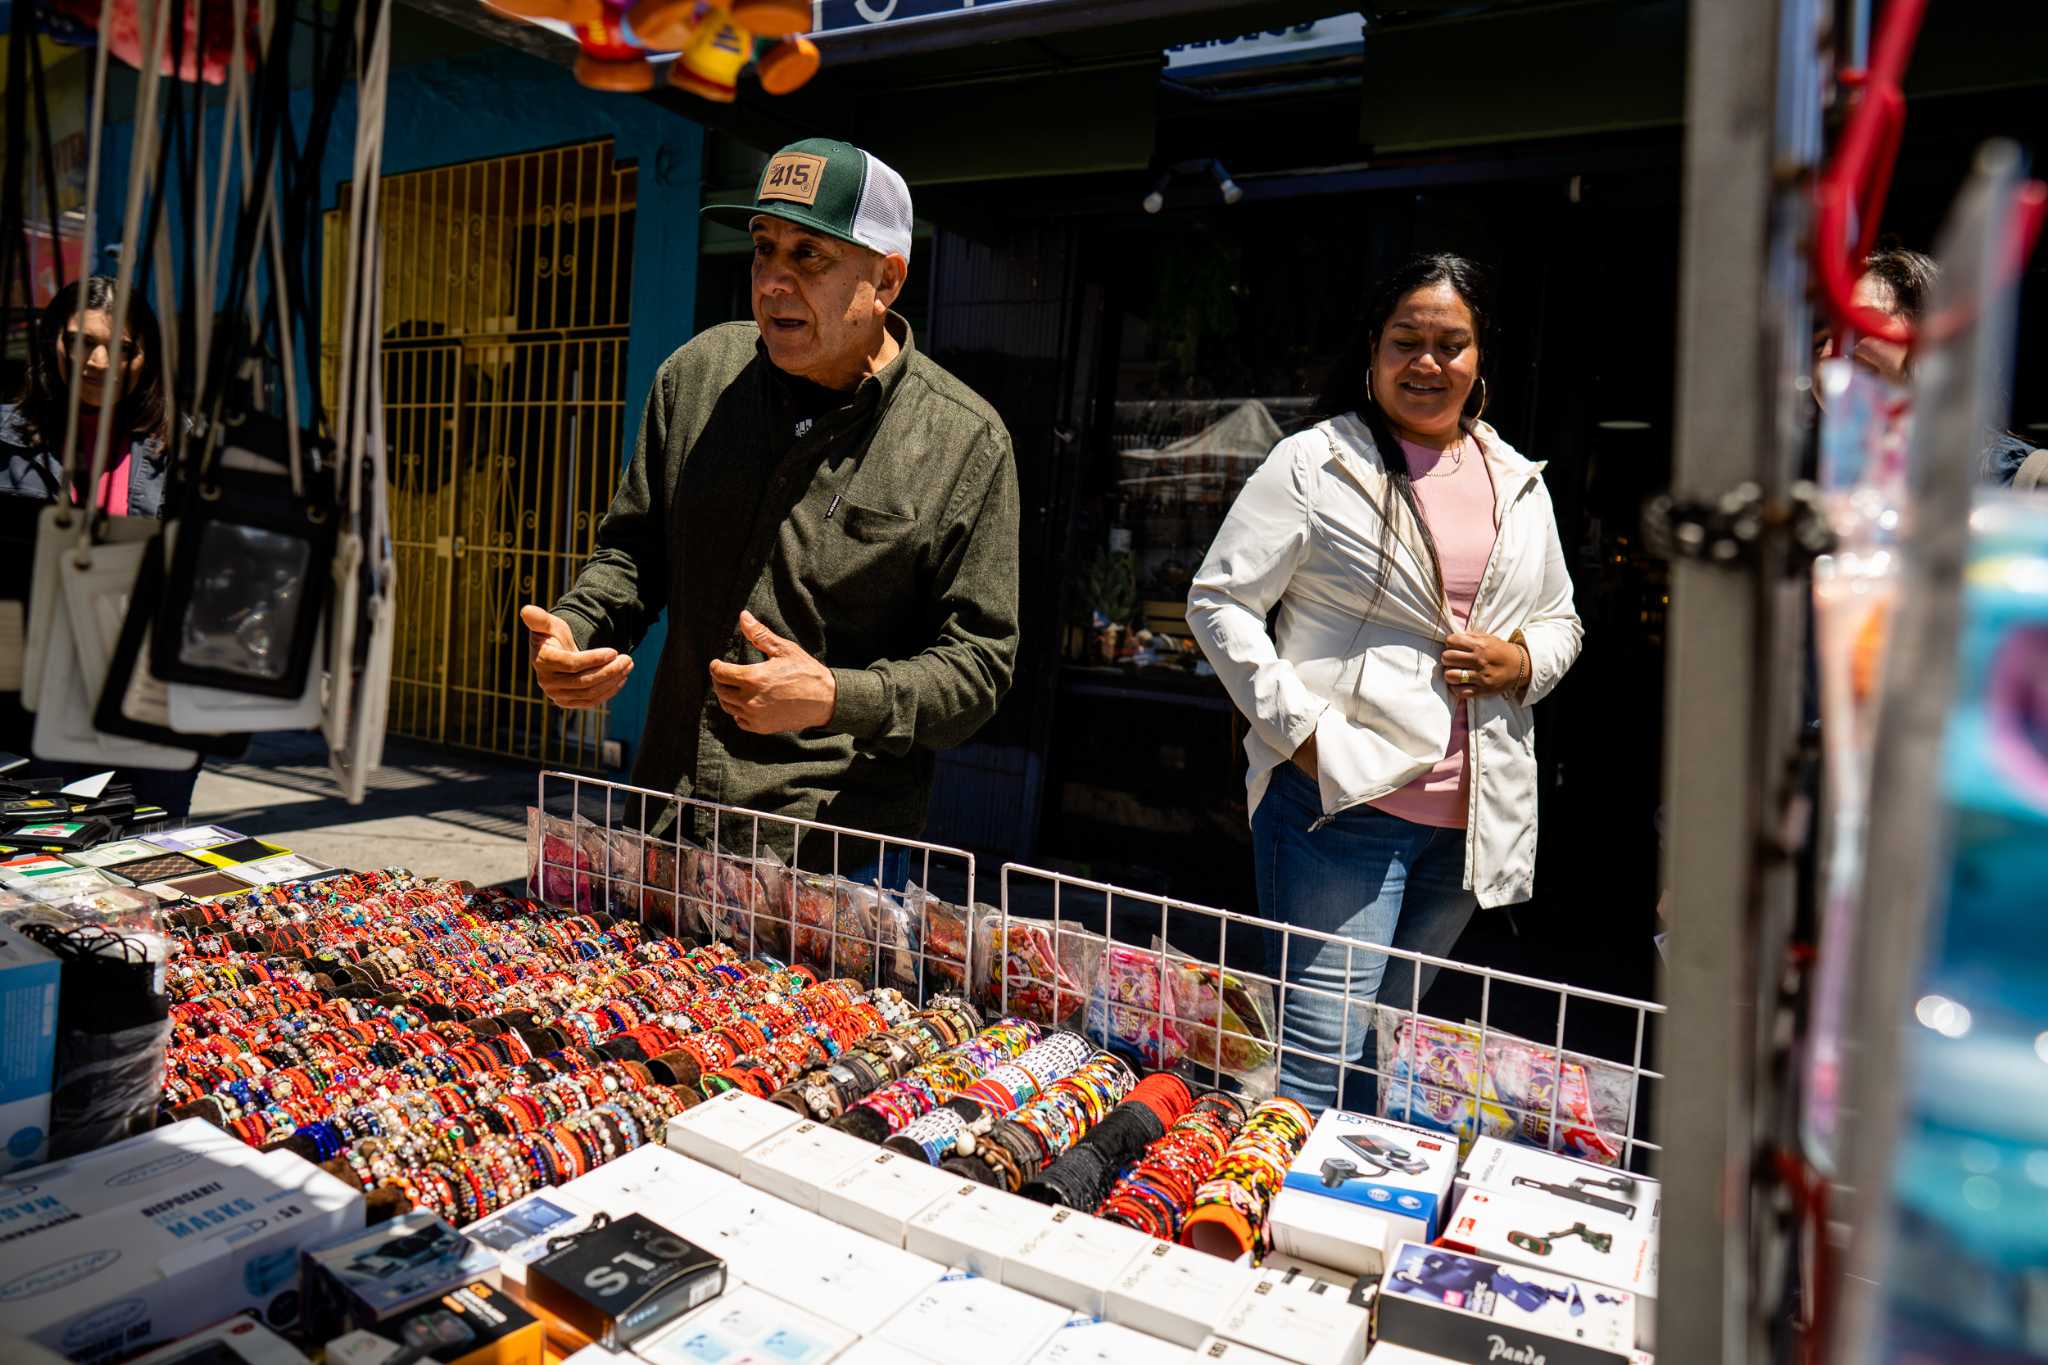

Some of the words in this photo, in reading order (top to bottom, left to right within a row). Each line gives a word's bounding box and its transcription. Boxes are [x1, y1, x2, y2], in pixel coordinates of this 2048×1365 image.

[770, 164, 810, 187] 415
[167, 1197, 256, 1239] MASKS
[584, 1236, 691, 1297] S10
